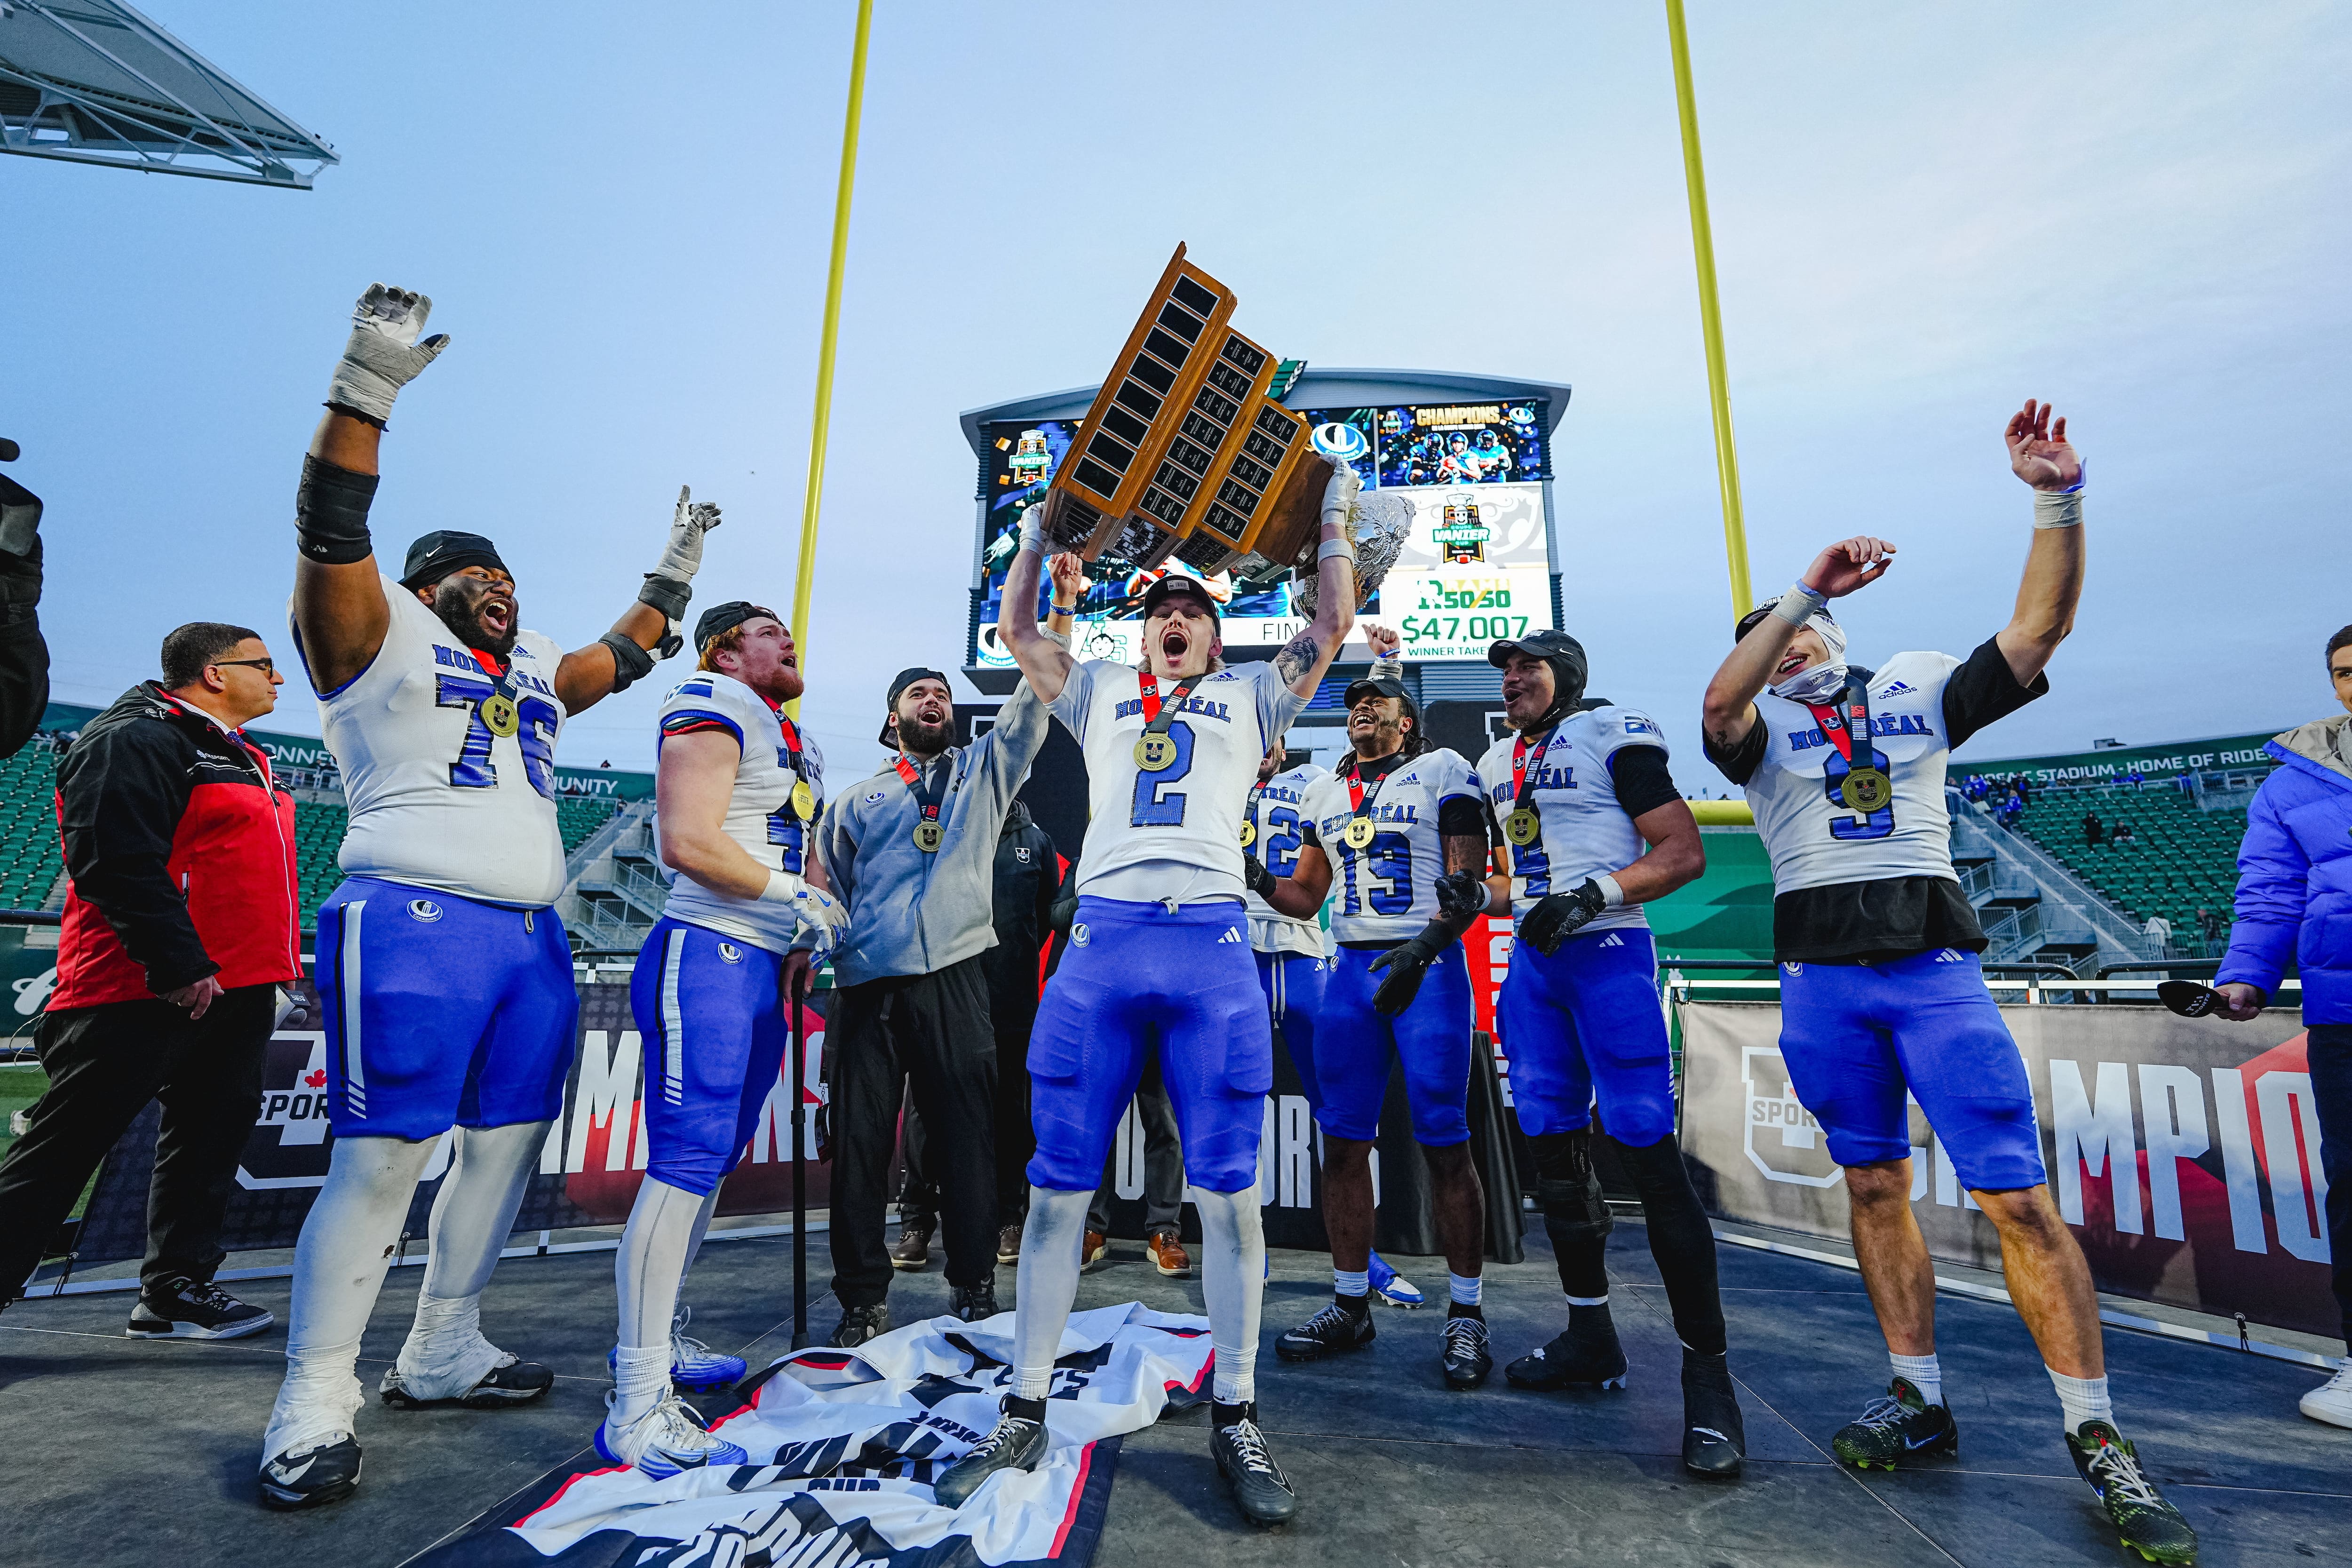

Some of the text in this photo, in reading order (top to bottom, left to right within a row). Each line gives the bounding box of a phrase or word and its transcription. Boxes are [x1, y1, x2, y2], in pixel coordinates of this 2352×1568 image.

[1231, 343, 1240, 357] UNIVERSITY
[1243, 351, 1252, 365] UNIVERSITY
[1221, 368, 1229, 382] UNIVERSITY
[1416, 406, 1500, 426] CHAMPIONS
[1203, 426, 1211, 440] UNIVERSITY
[1011, 457, 1050, 466] VANIER
[1162, 467, 1173, 485] SASKATCHEWAN
[1149, 492, 1160, 510] SASKATCHEWAN
[1213, 509, 1222, 523] UNIVERSITY
[1225, 516, 1233, 530] UNIVERSITY
[1434, 529, 1490, 541] VANIER
[1445, 590, 1510, 608] 50/50
[1263, 623, 1310, 640] FIN
[1402, 615, 1529, 644] $47,007
[1408, 647, 1454, 656] WINNER
[1162, 686, 1190, 714] FOOTBALL 2025
[1879, 686, 1918, 700] adidas
[1115, 695, 1231, 724] MORÉAL
[1788, 712, 1934, 751] MORÉAL
[1851, 705, 1867, 740] FOOTBALL 2025
[435, 673, 558, 803] 76
[1138, 735, 1173, 746] NATIONAL CHAMPIONSHIP
[1129, 718, 1196, 828] 2
[1156, 760, 1170, 768] NATIONAL
[1525, 746, 1546, 782] FOOTBALL 2025
[2036, 748, 2270, 781] STADIUM HOME OF RIDE
[554, 776, 618, 795] UNITY
[1366, 772, 1388, 798] FOOTBALL 2025
[1846, 771, 1885, 785] NATIONAL CHAMPIONSHIP
[1248, 788, 1262, 803] FOOTBALL
[1822, 746, 1896, 840] 9
[927, 805, 938, 818] 2025
[1850, 796, 1888, 810] CHAMPIONNAT NATIONAL
[1322, 801, 1419, 837] MONRÉAL
[1244, 803, 1303, 878] 12
[1513, 798, 1551, 899] 4
[1336, 831, 1414, 916] 19
[1752, 1100, 1817, 1128] SPOR
